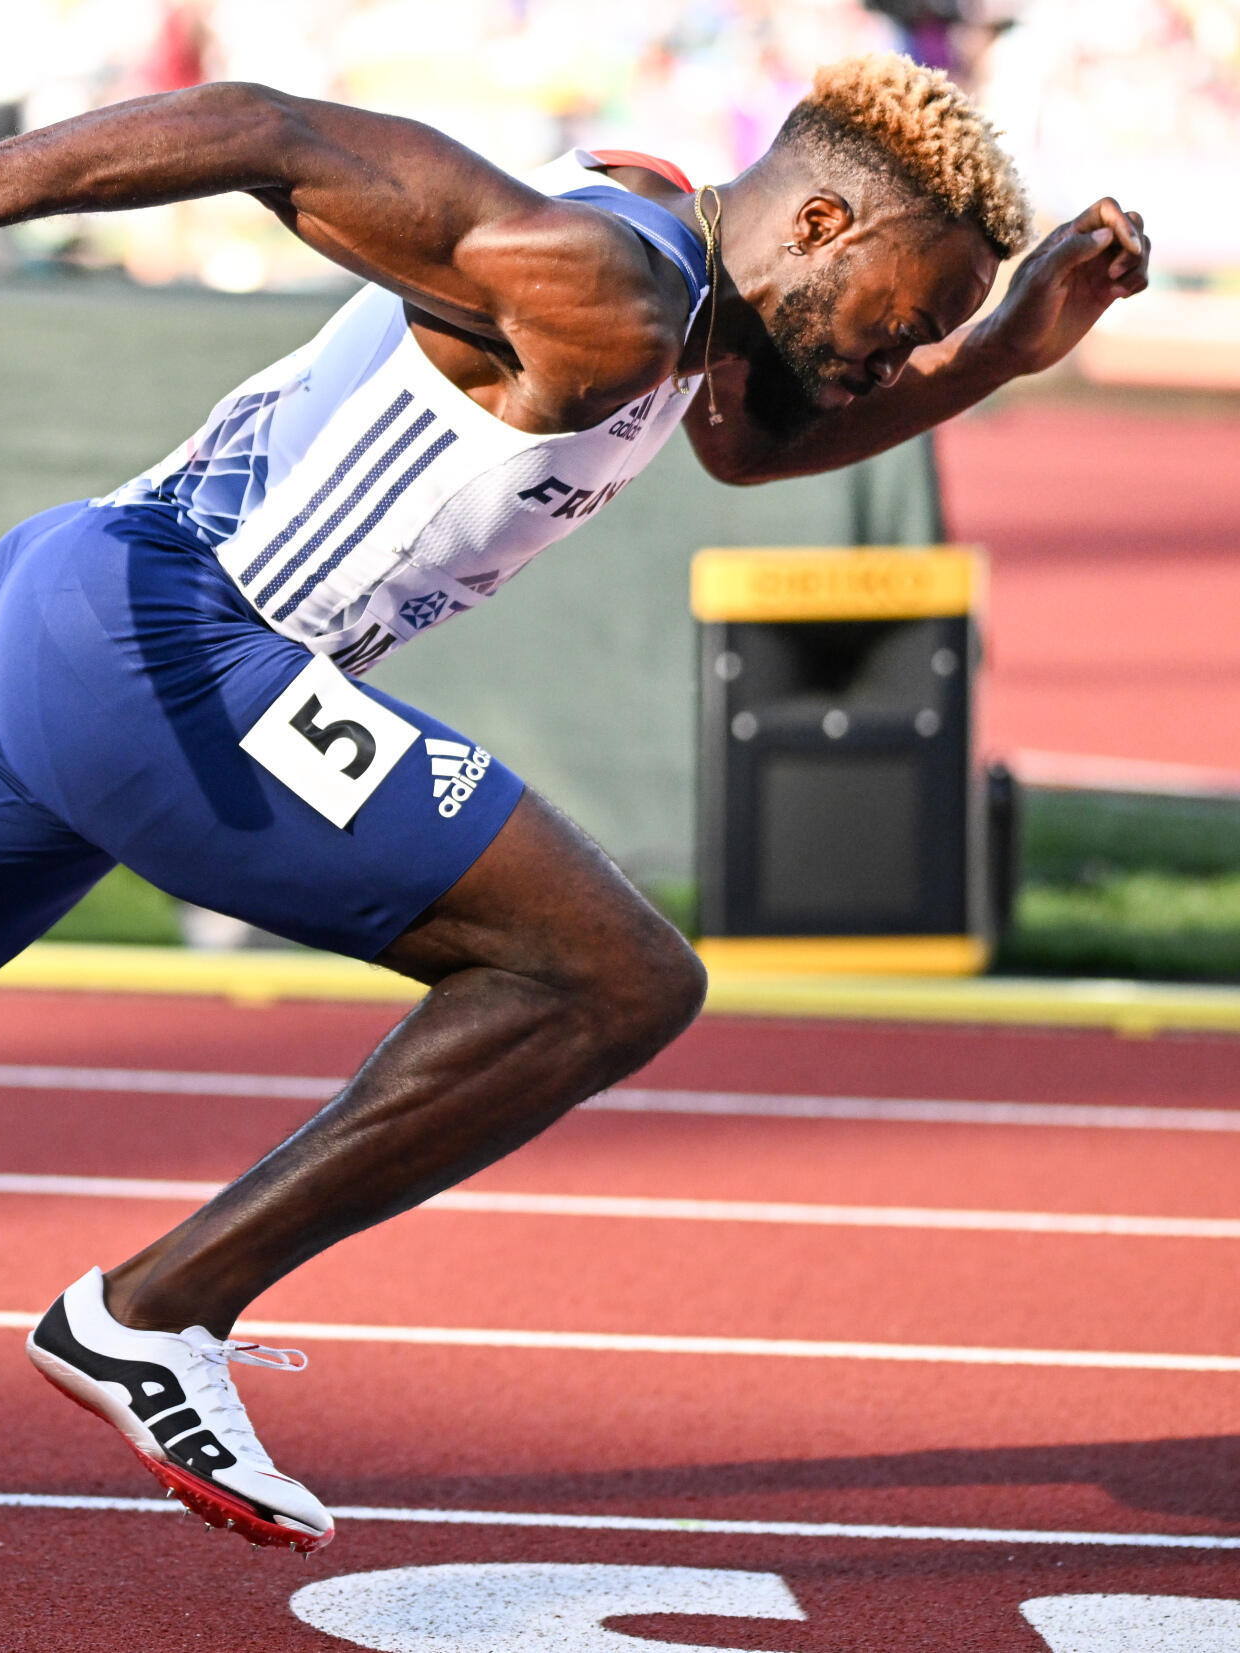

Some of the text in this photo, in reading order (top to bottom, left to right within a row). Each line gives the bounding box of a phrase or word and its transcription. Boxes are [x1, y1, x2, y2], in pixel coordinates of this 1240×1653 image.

[288, 693, 377, 780] 5
[438, 745, 491, 818] adidas
[112, 1362, 237, 1480] AIR
